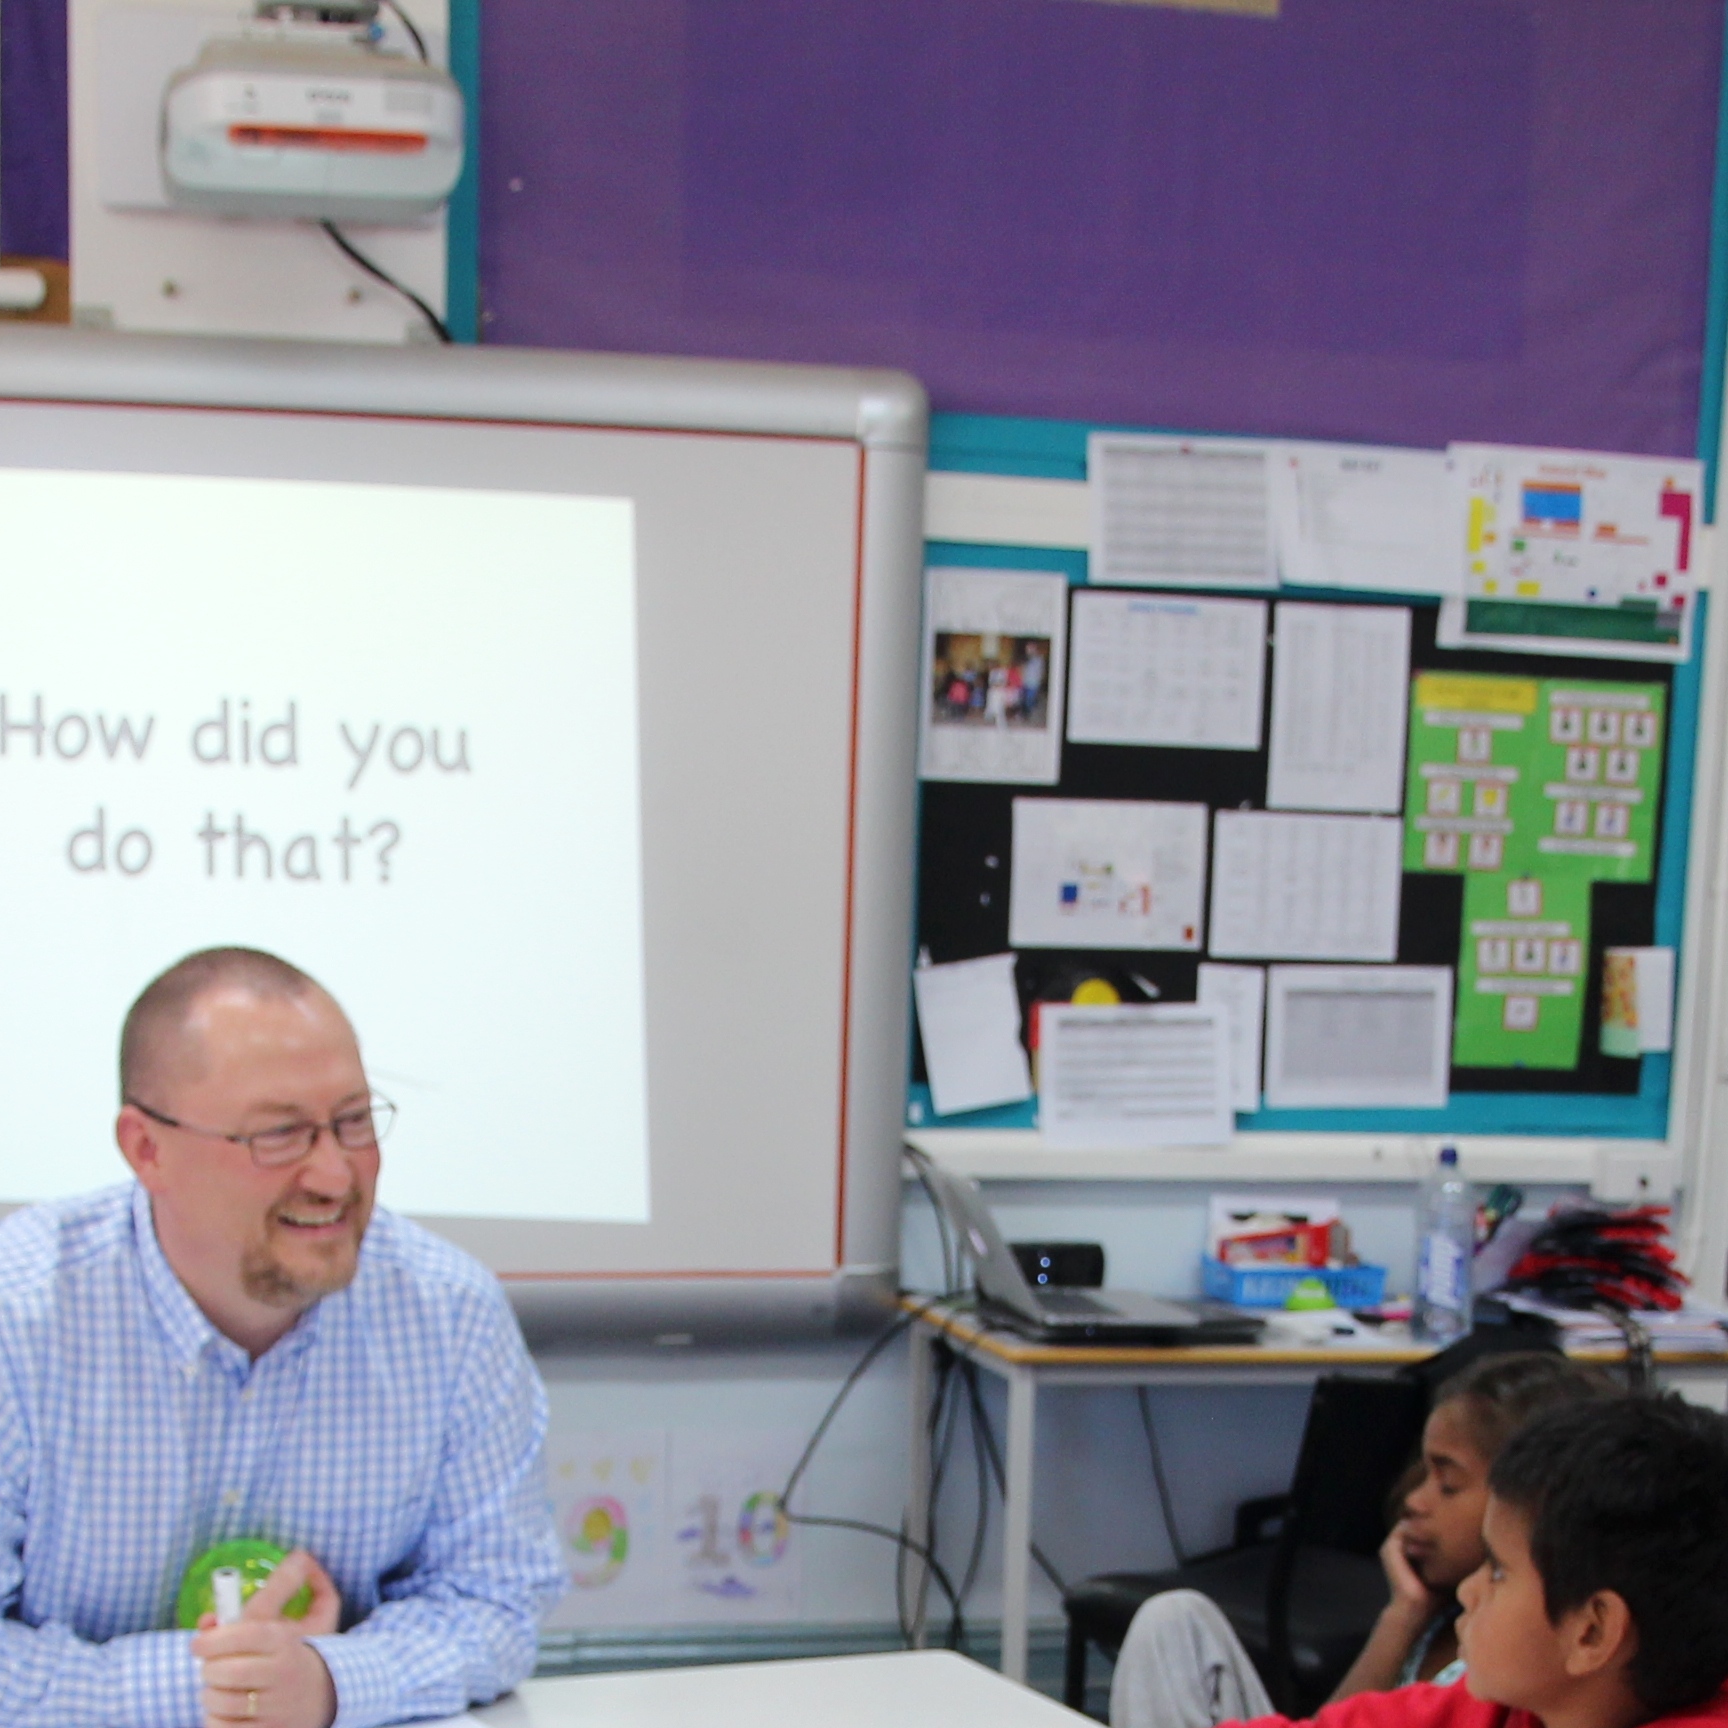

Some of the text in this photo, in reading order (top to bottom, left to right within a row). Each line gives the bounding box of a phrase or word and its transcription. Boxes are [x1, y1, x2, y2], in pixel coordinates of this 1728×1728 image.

[191, 698, 299, 767] did
[338, 720, 472, 791] you
[67, 806, 402, 885] do that?
[566, 1490, 790, 1589] 9 10
